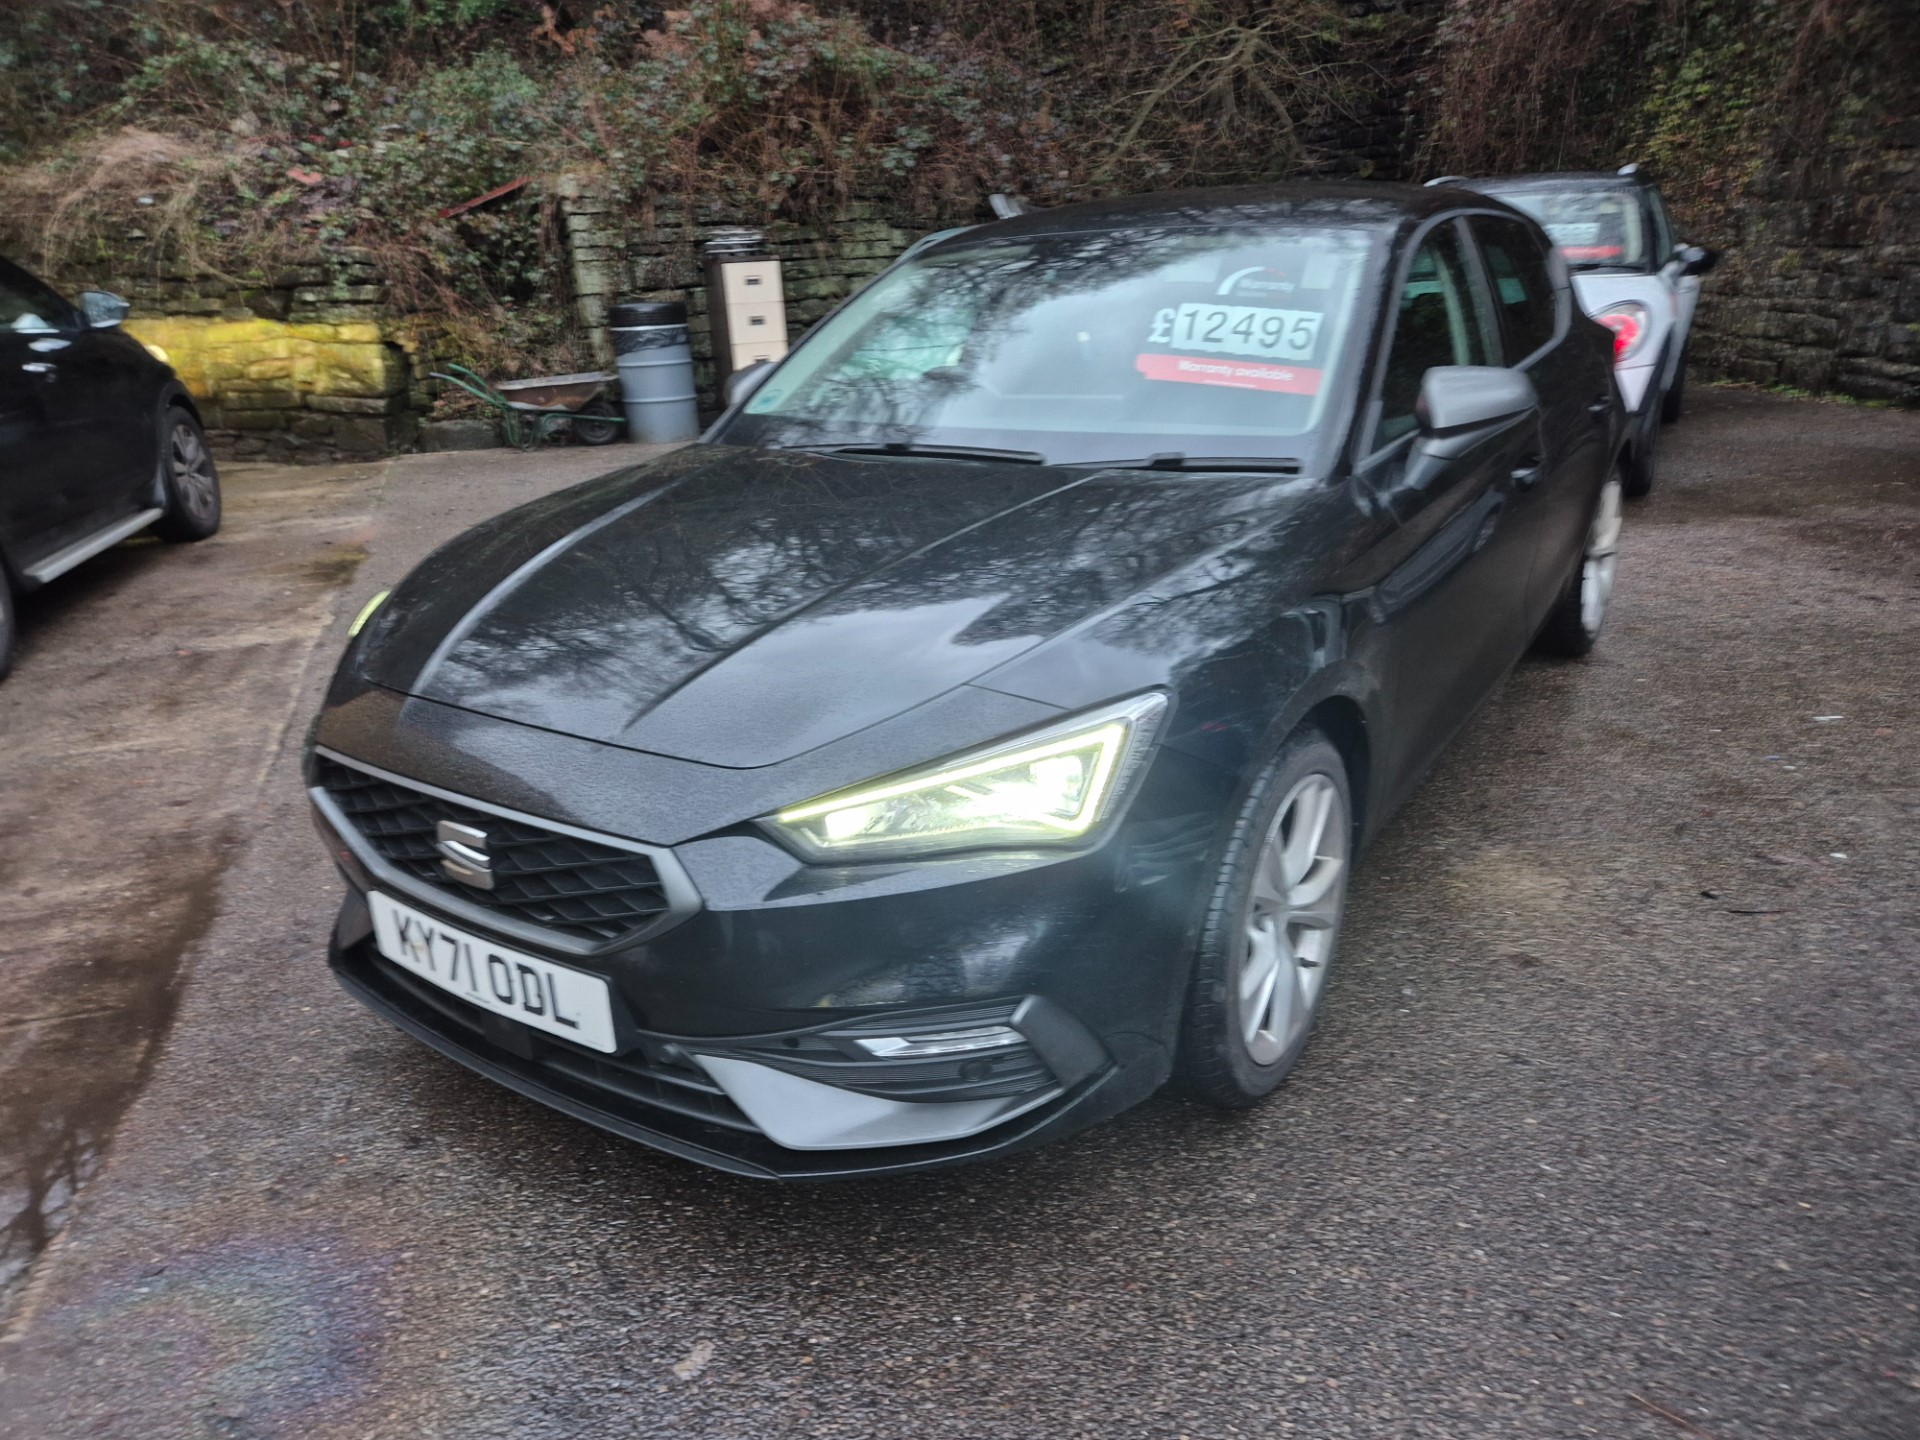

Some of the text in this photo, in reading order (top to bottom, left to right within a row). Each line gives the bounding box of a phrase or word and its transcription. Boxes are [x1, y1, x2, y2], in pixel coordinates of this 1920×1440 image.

[1147, 308, 1317, 351] £12495
[392, 909, 580, 1030] KY71 ODL
